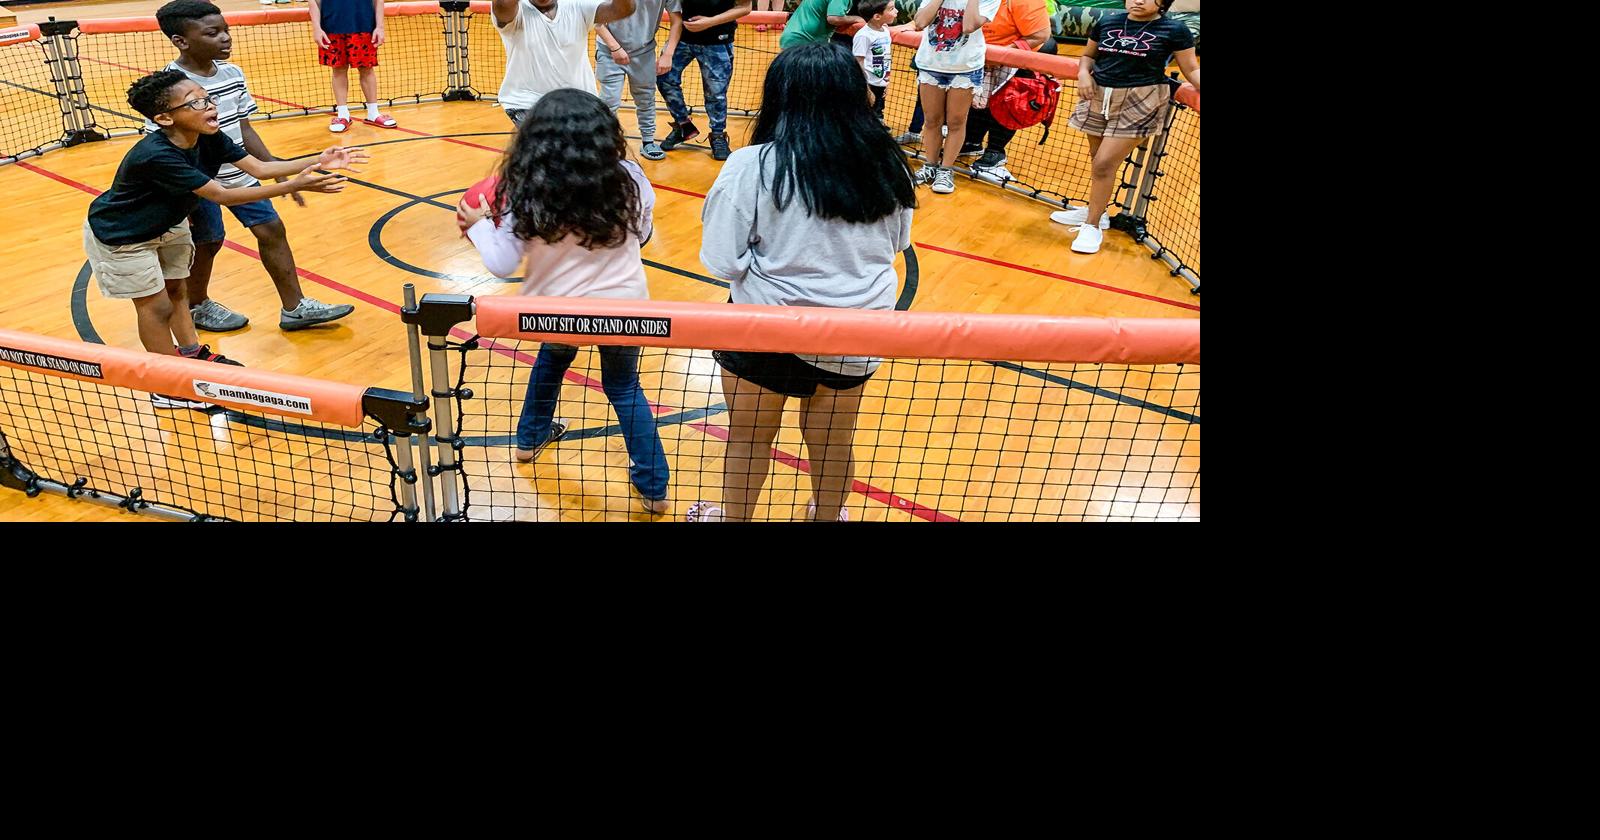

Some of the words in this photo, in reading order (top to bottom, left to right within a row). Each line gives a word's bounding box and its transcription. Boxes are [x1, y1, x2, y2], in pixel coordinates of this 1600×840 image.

[1118, 49, 1147, 57] ARMOUR
[521, 316, 536, 331] DO
[538, 316, 558, 332] NOT
[559, 317, 575, 332] SIT
[576, 317, 591, 333] OR
[591, 318, 623, 334] STAND
[624, 318, 639, 334] ON
[640, 319, 668, 335] SIDES
[0, 348, 10, 361] DO
[9, 350, 25, 364] NOT
[24, 353, 37, 366] SIT
[36, 355, 48, 368] OR
[46, 357, 70, 371] STAND
[69, 361, 81, 374] ON
[79, 363, 101, 377] SIDES
[218, 388, 309, 410] mambagaga.com
